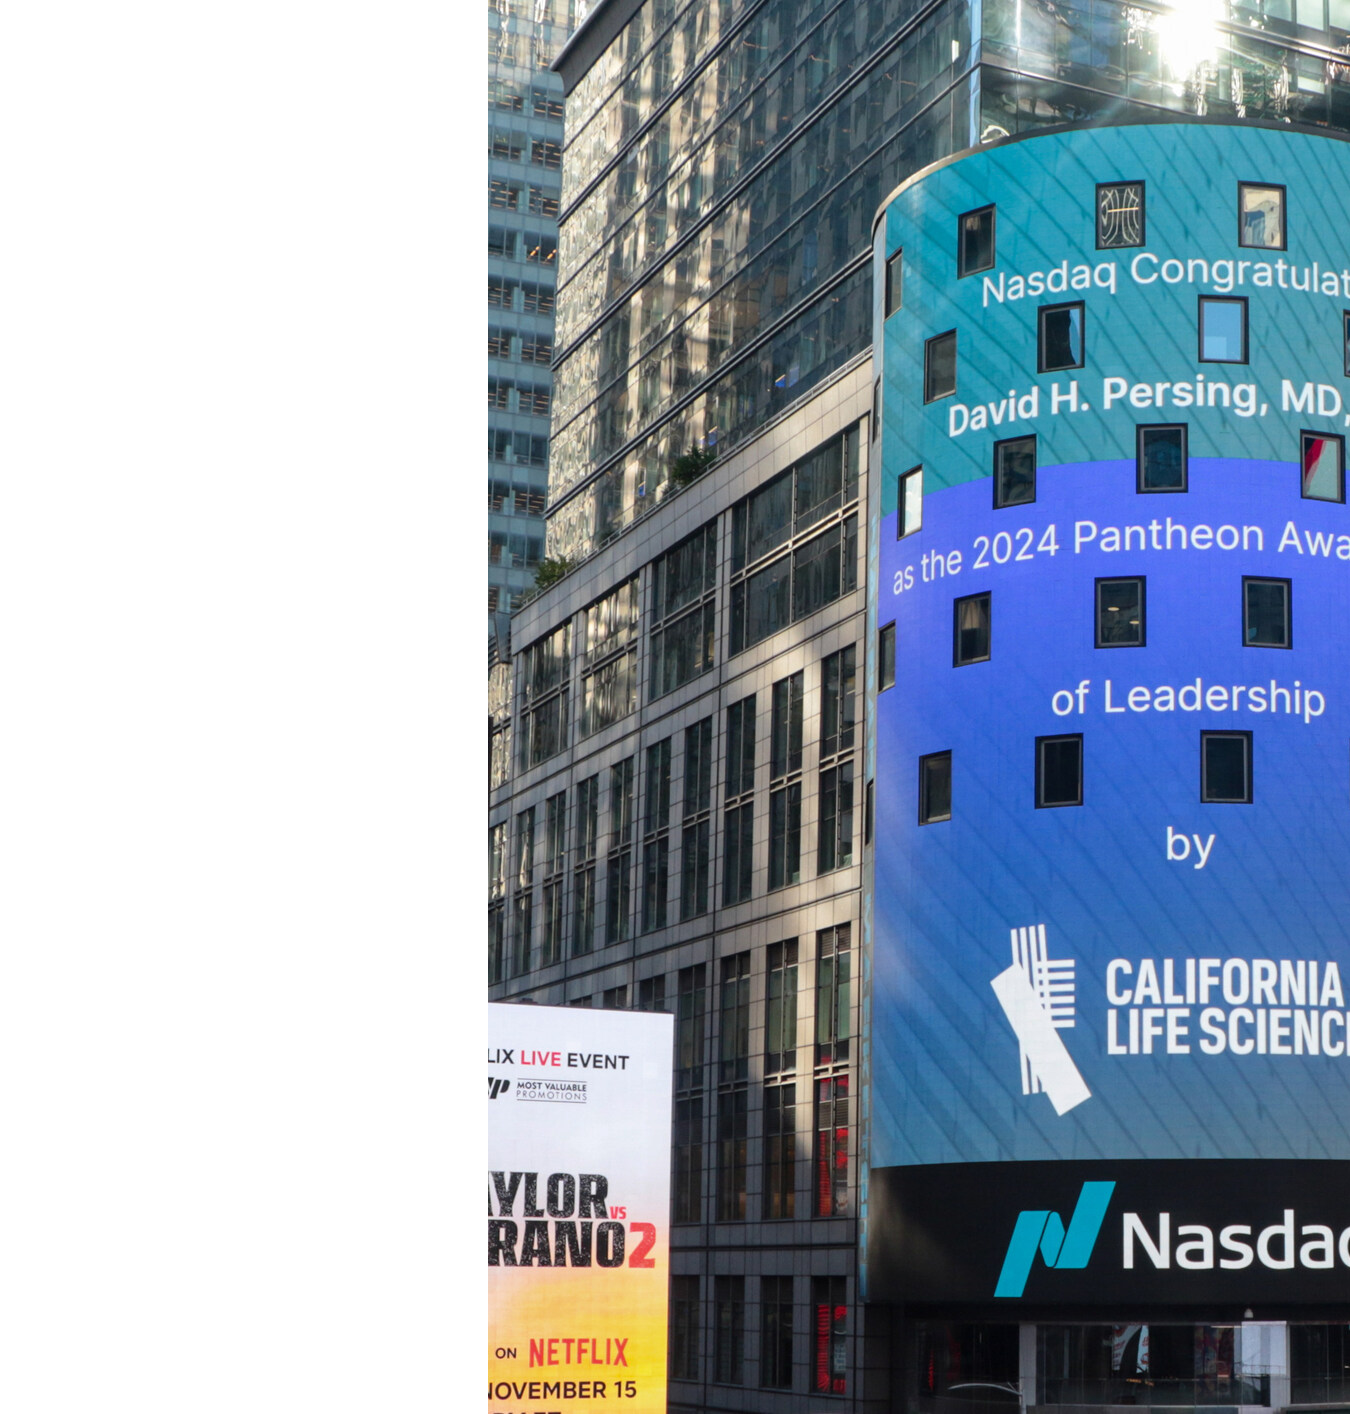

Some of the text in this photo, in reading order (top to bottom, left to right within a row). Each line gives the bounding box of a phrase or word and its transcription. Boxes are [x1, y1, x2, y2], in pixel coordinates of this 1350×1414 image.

[983, 260, 1116, 307] Nasdaq
[949, 386, 1038, 437] David
[1052, 380, 1090, 414] H.
[1103, 373, 1268, 418] Persing,
[893, 566, 914, 596] as
[920, 550, 963, 583] the
[973, 523, 1060, 569] 2024
[1074, 517, 1264, 554] Pantheon
[1052, 678, 1326, 724] of Leadership
[1167, 826, 1216, 869] by
[1106, 958, 1345, 1007] CALIFORNIA
[1107, 1008, 1191, 1055] LIFE
[488, 1048, 630, 1070] LIX LIVE EVENT
[516, 1090, 588, 1101] PROMOTIONS
[517, 1081, 587, 1092] MOST VALUABLE
[488, 1171, 627, 1220] YLOR VS
[495, 1338, 629, 1368] ON NETFLIX
[614, 1381, 637, 1398] 15
